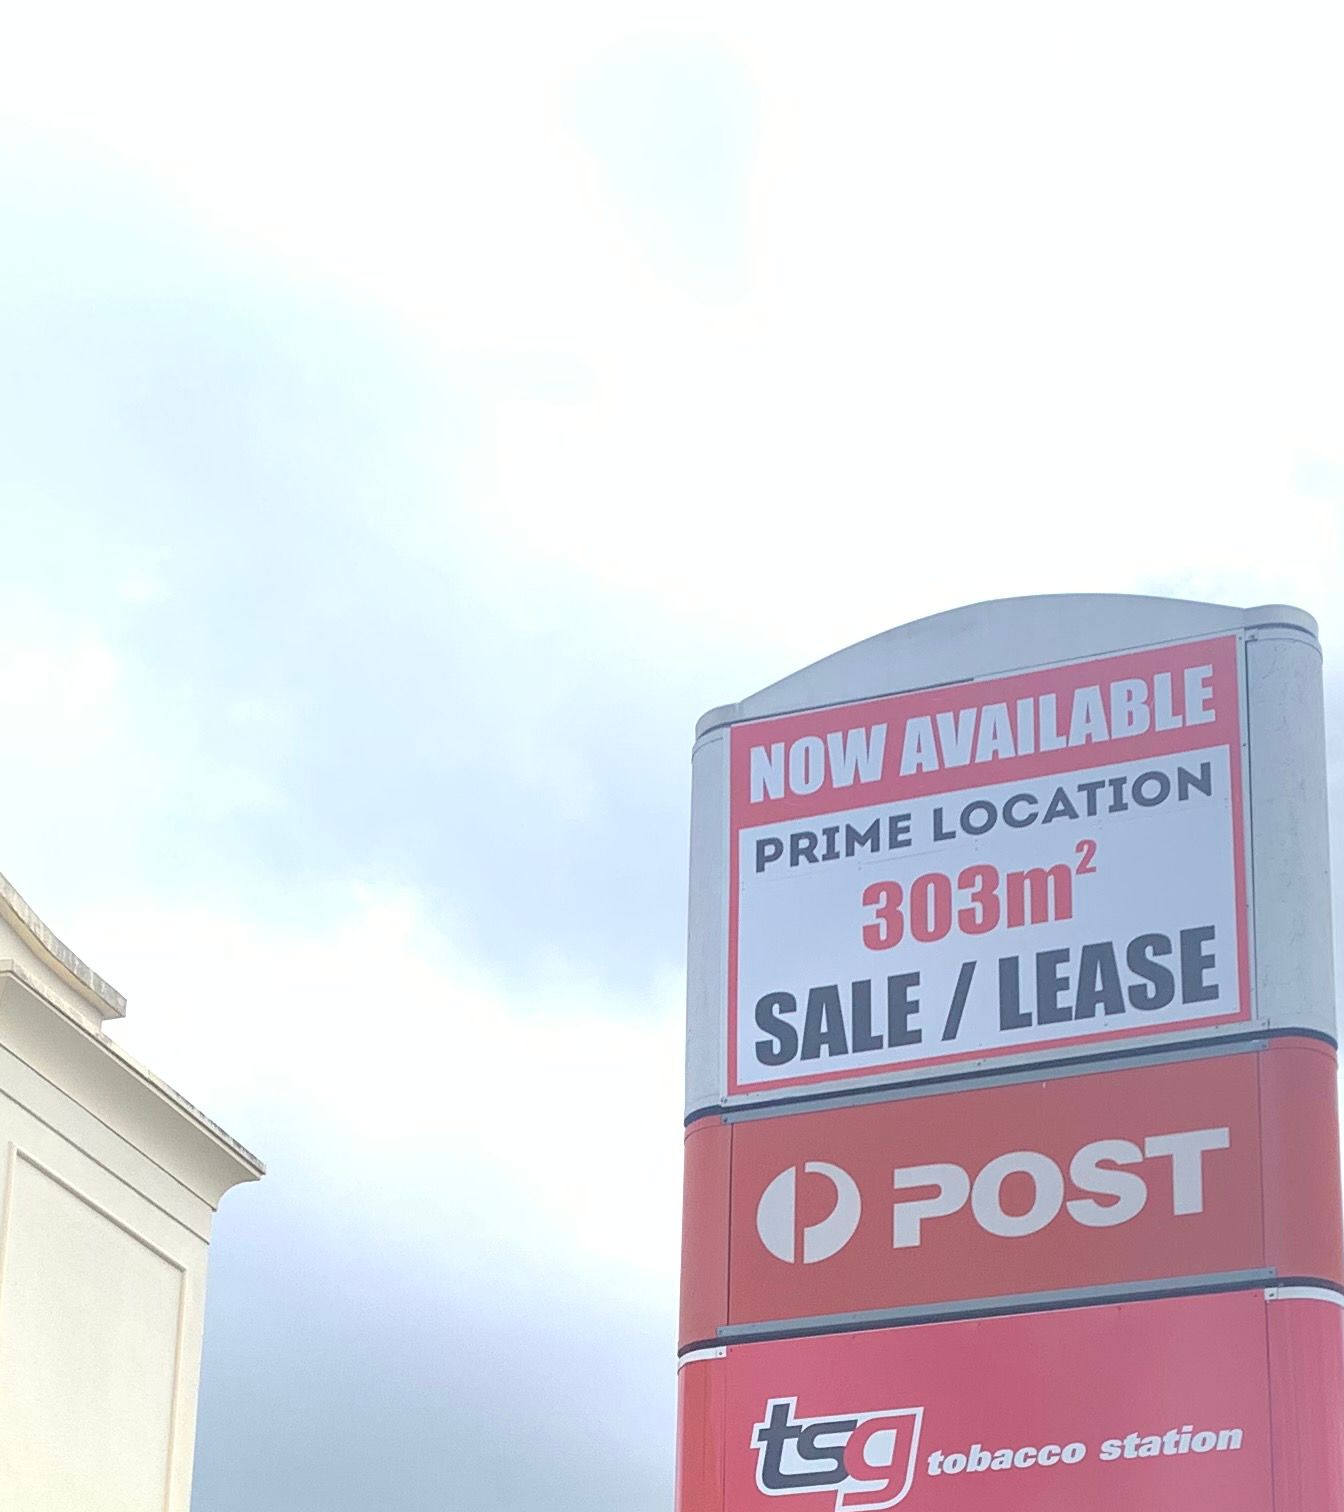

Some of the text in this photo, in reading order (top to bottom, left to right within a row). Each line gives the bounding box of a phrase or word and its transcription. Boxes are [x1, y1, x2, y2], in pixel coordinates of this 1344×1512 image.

[750, 664, 1216, 804] NOW AVAILABLE
[755, 761, 1213, 874] PRIME LOCATION
[754, 924, 1219, 1067] SALE / LEASE
[892, 1127, 1231, 1250] POST
[927, 1441, 1086, 1477] tobacco
[1099, 1425, 1244, 1462] station
